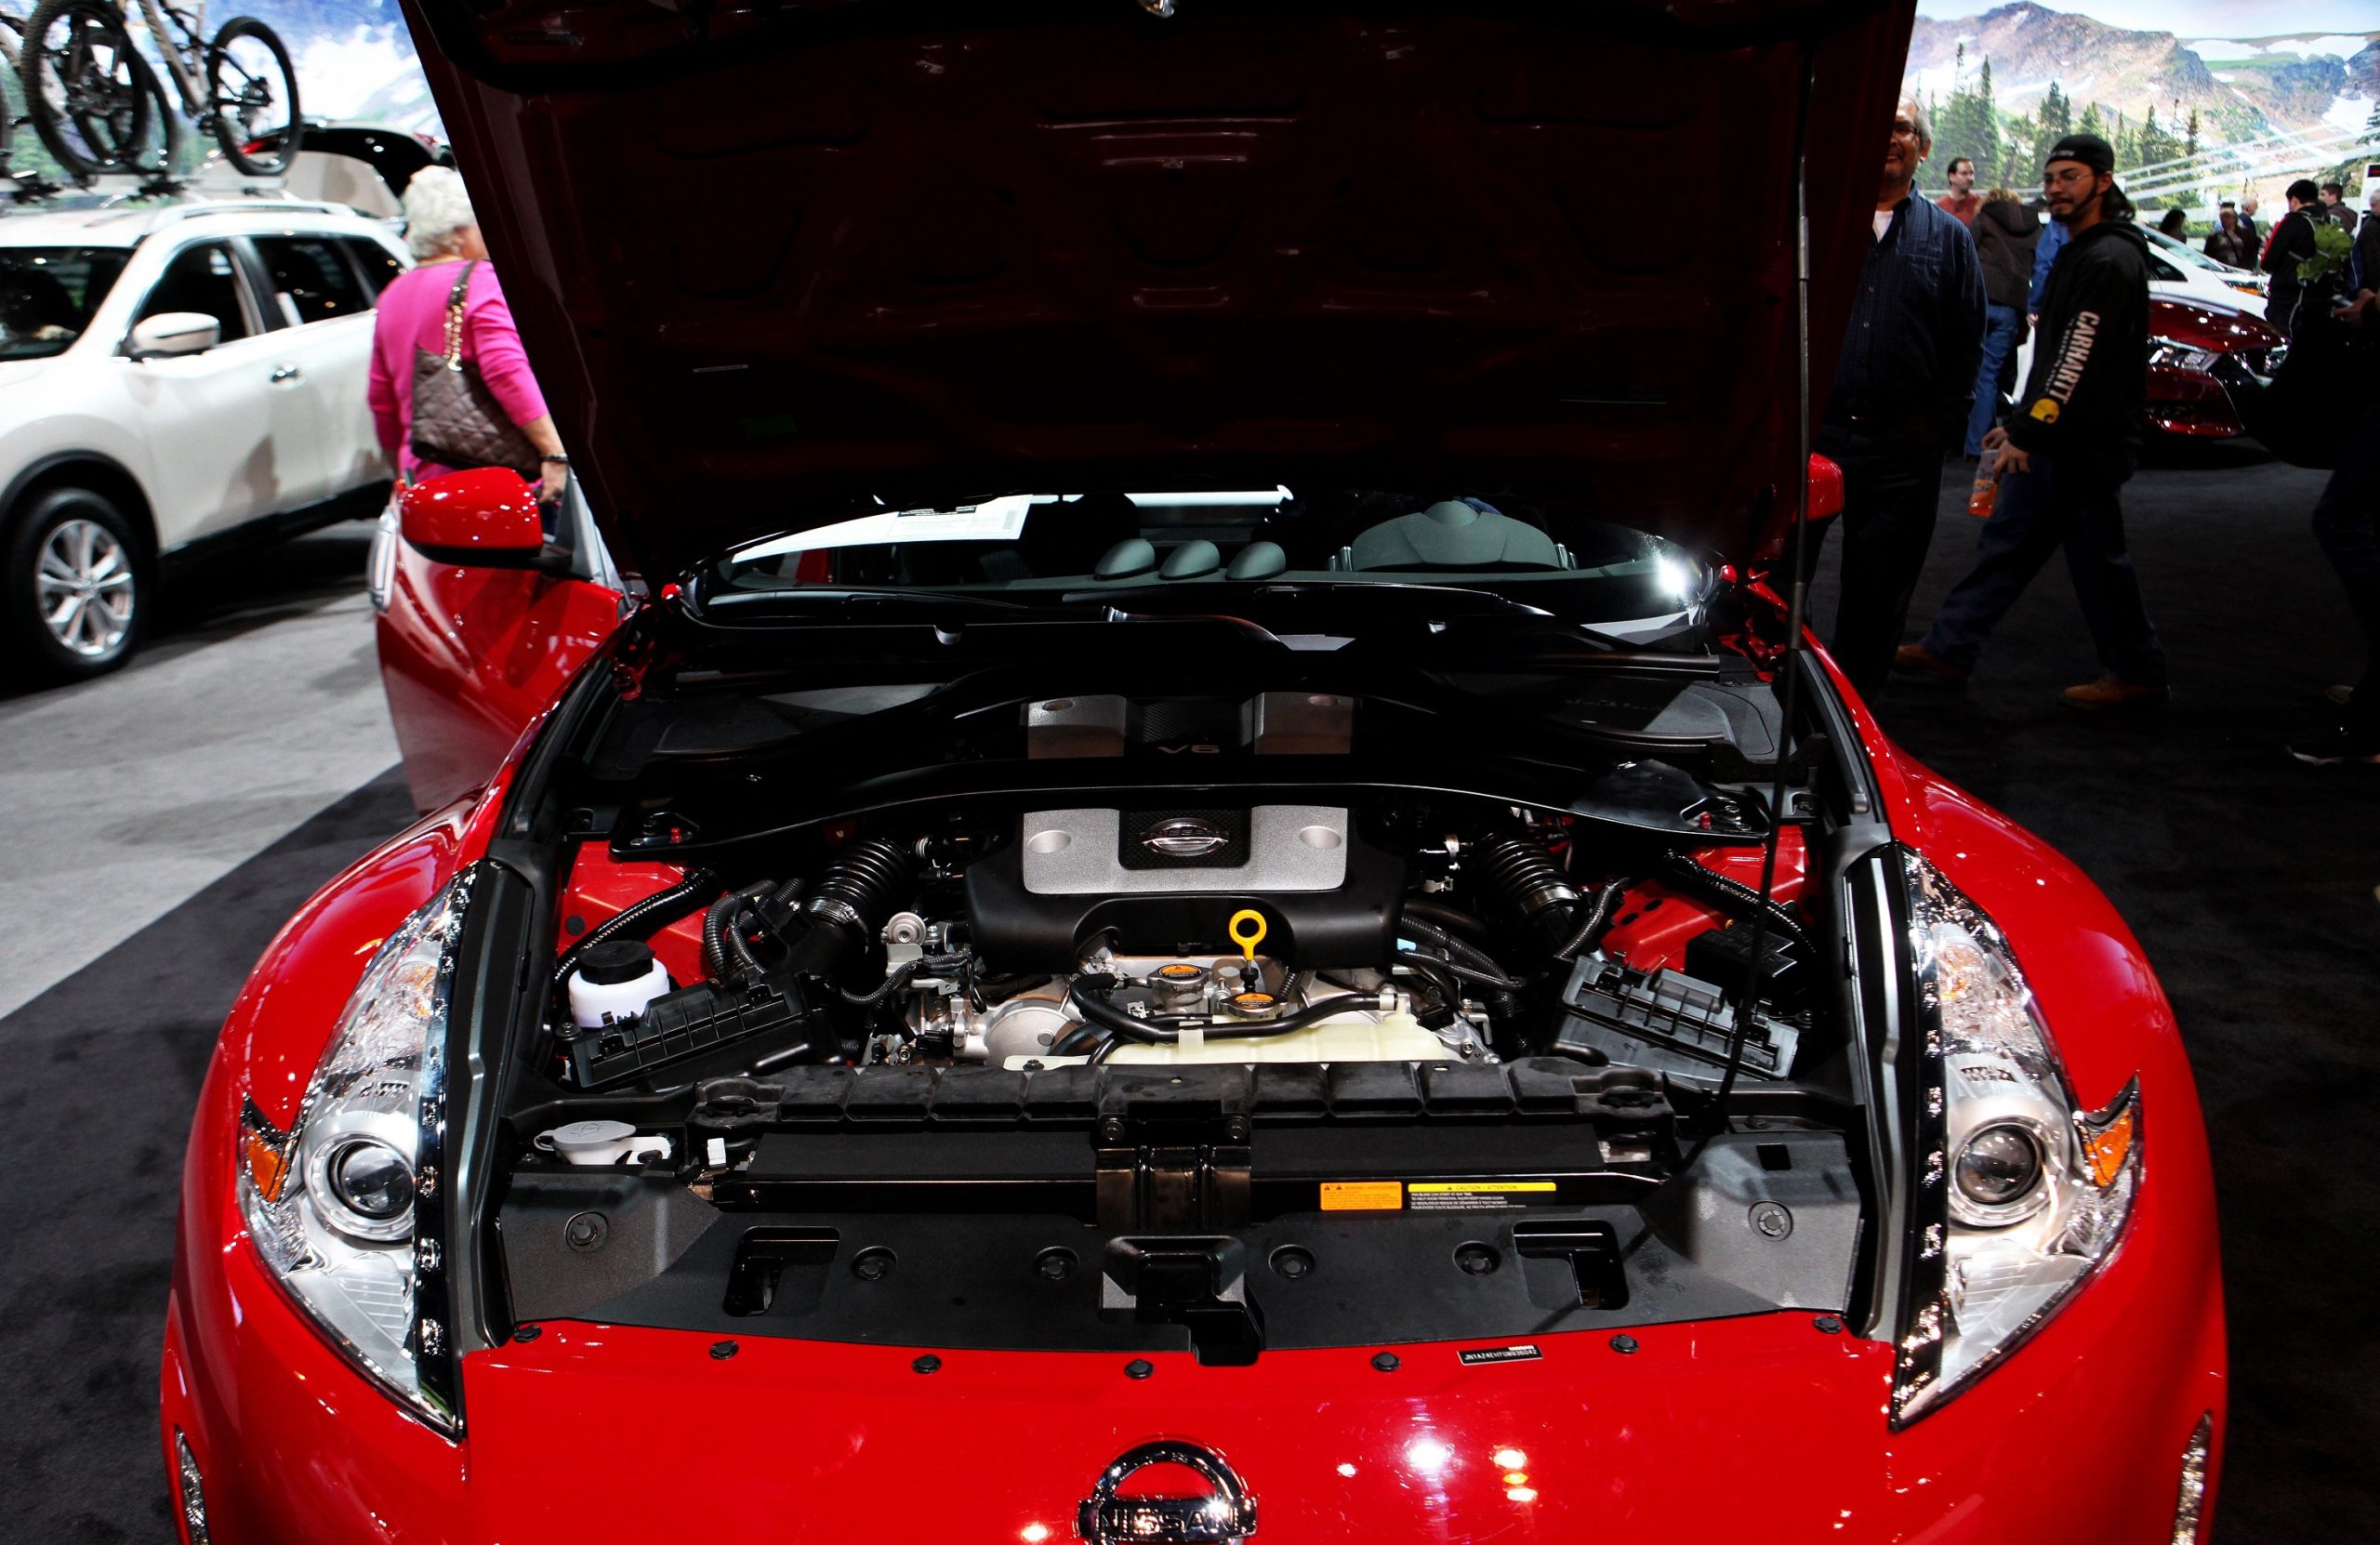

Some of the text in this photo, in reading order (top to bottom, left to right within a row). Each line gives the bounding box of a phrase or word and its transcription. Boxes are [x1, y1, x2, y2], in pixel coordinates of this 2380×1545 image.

[2048, 310, 2101, 404] CARHARTT
[1157, 745, 1222, 755] V6
[1094, 1509, 1239, 1534] NISSAN
